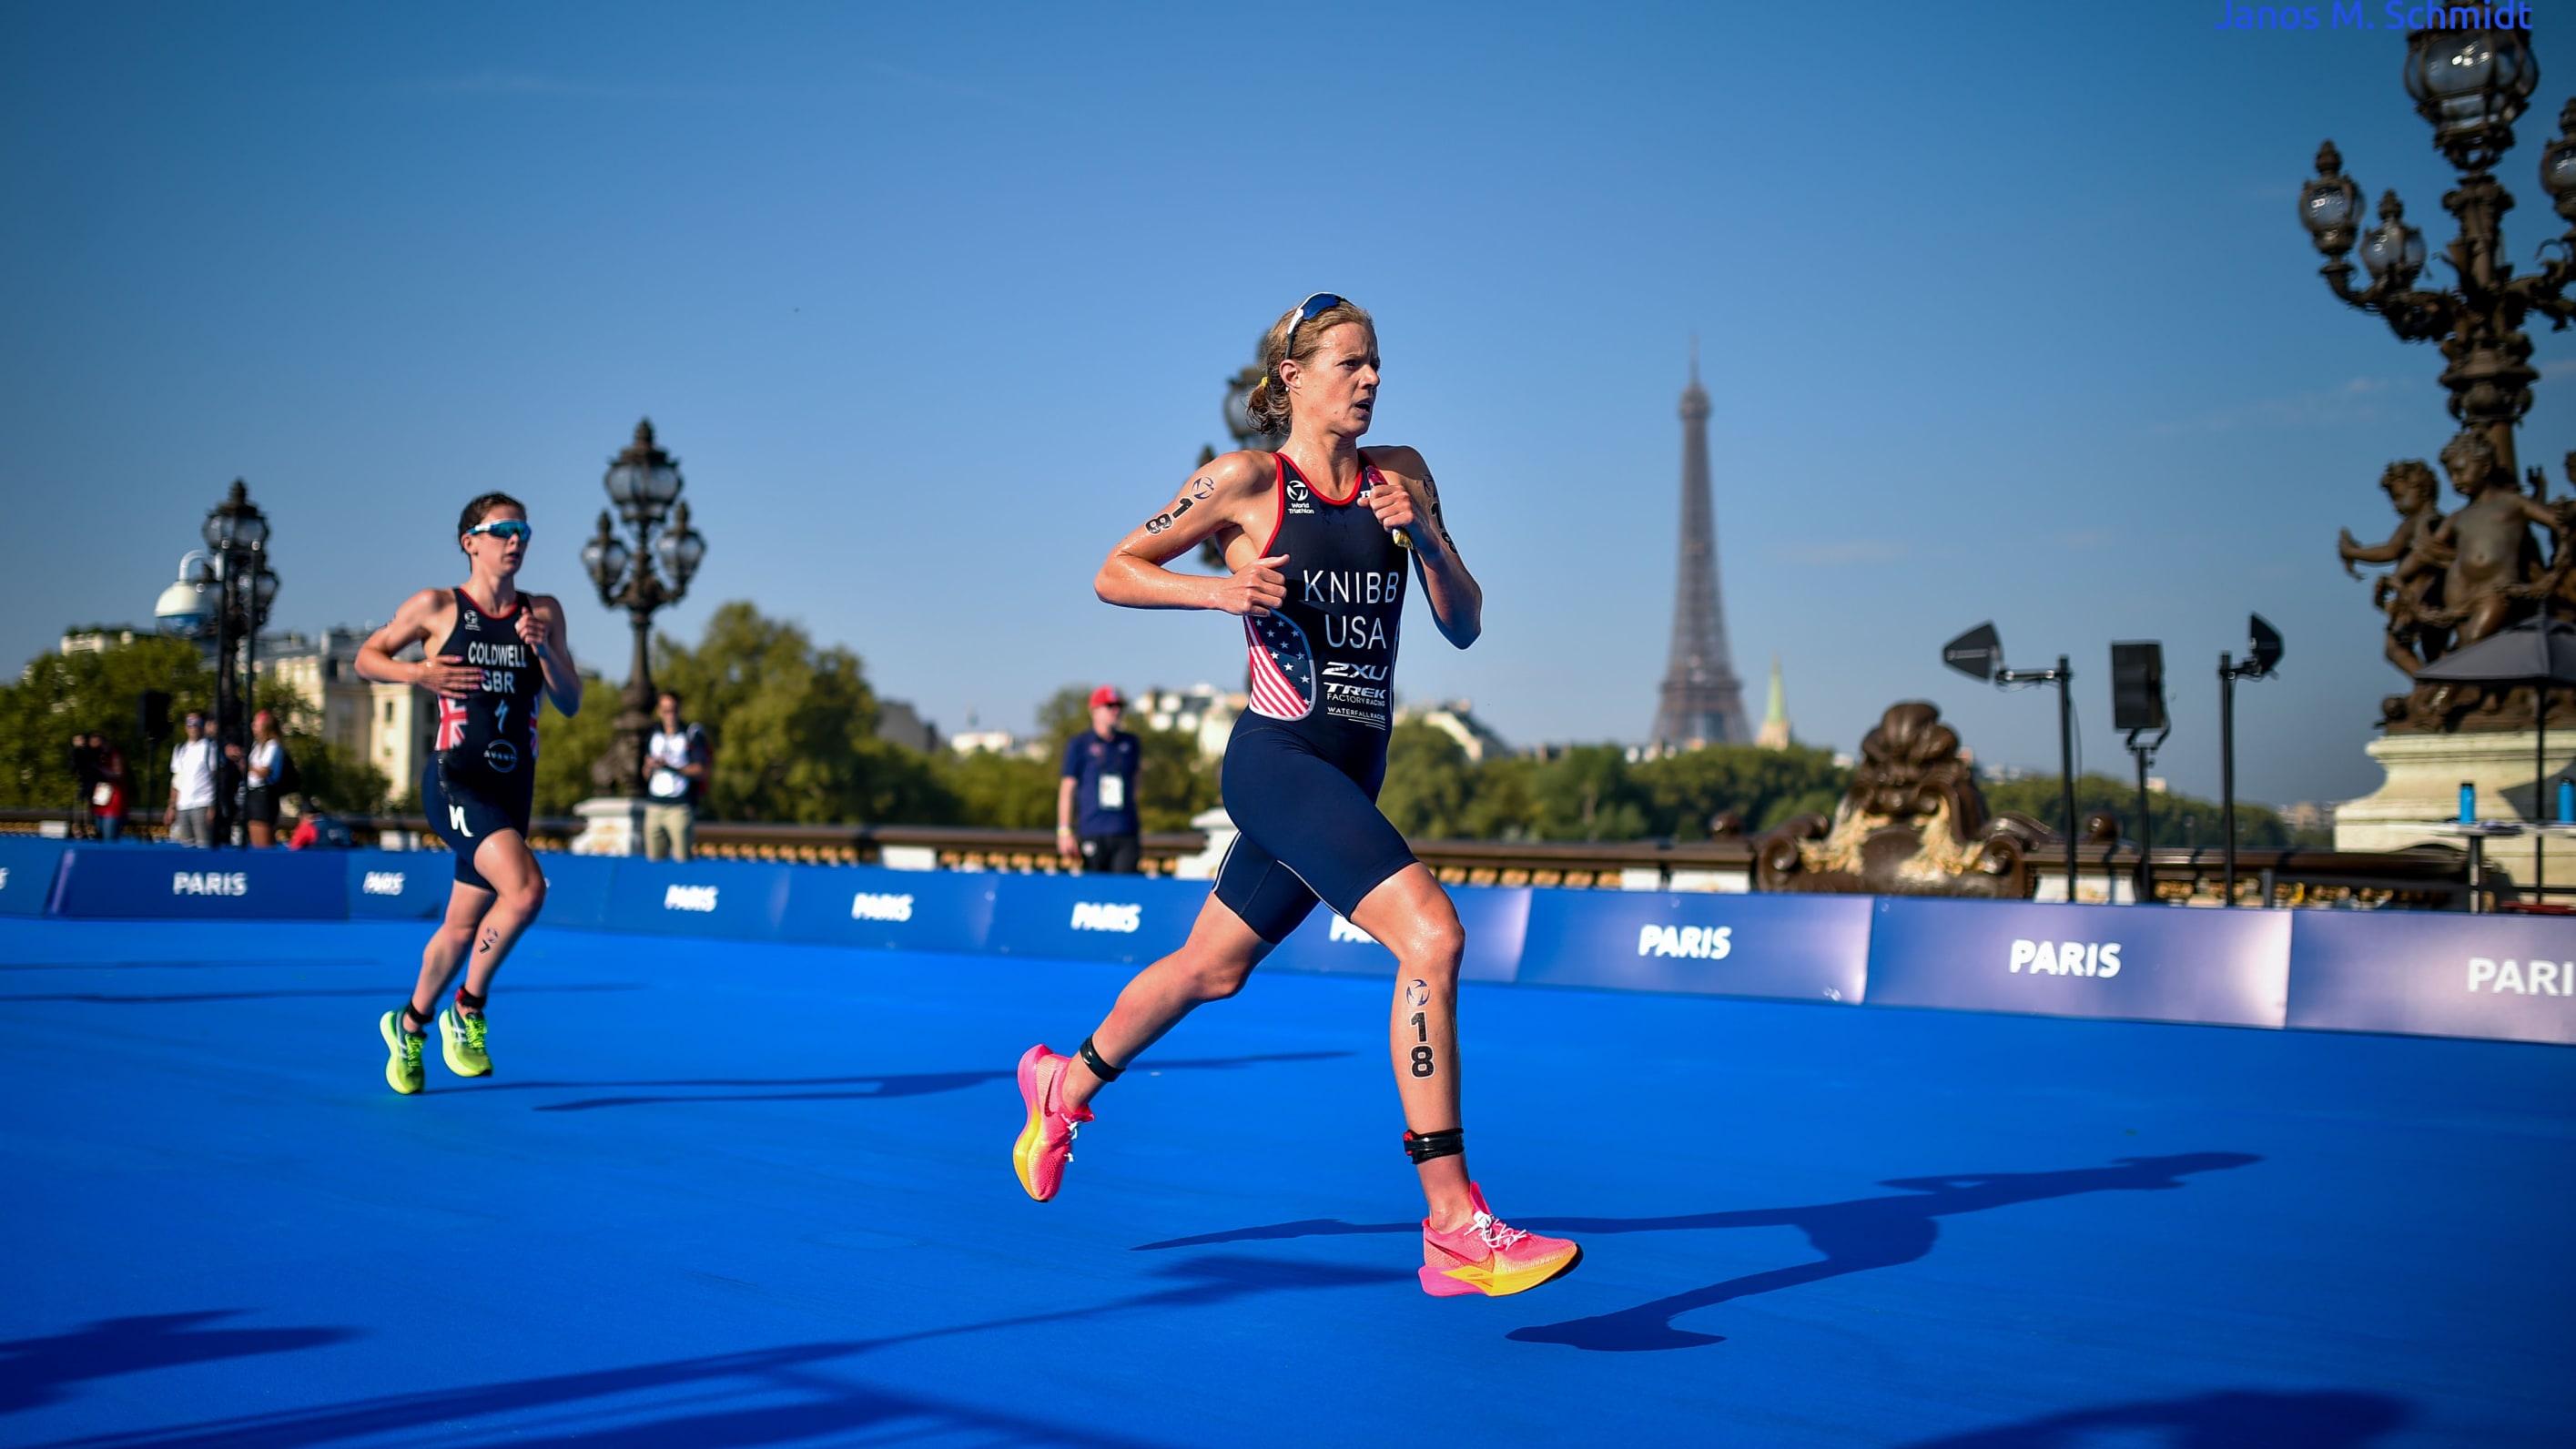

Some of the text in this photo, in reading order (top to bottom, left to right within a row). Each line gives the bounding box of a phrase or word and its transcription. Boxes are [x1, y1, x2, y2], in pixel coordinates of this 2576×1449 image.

[1303, 569, 1399, 603] KNIBB
[1325, 613, 1387, 650] USA
[468, 640, 527, 667] COLDWELL
[482, 669, 515, 694] GBR
[1322, 661, 1388, 681] 2XU
[1323, 682, 1386, 699] TREK
[1326, 693, 1365, 704] FACTORY
[1327, 706, 1370, 718] WATERFALL
[173, 871, 248, 896] PARIS
[1070, 902, 1141, 933] PARIS
[1638, 924, 1732, 959] PARIS
[2009, 938, 2122, 978] PARIS
[2468, 957, 2574, 997] PARI
[1410, 1011, 1435, 1079] 18
